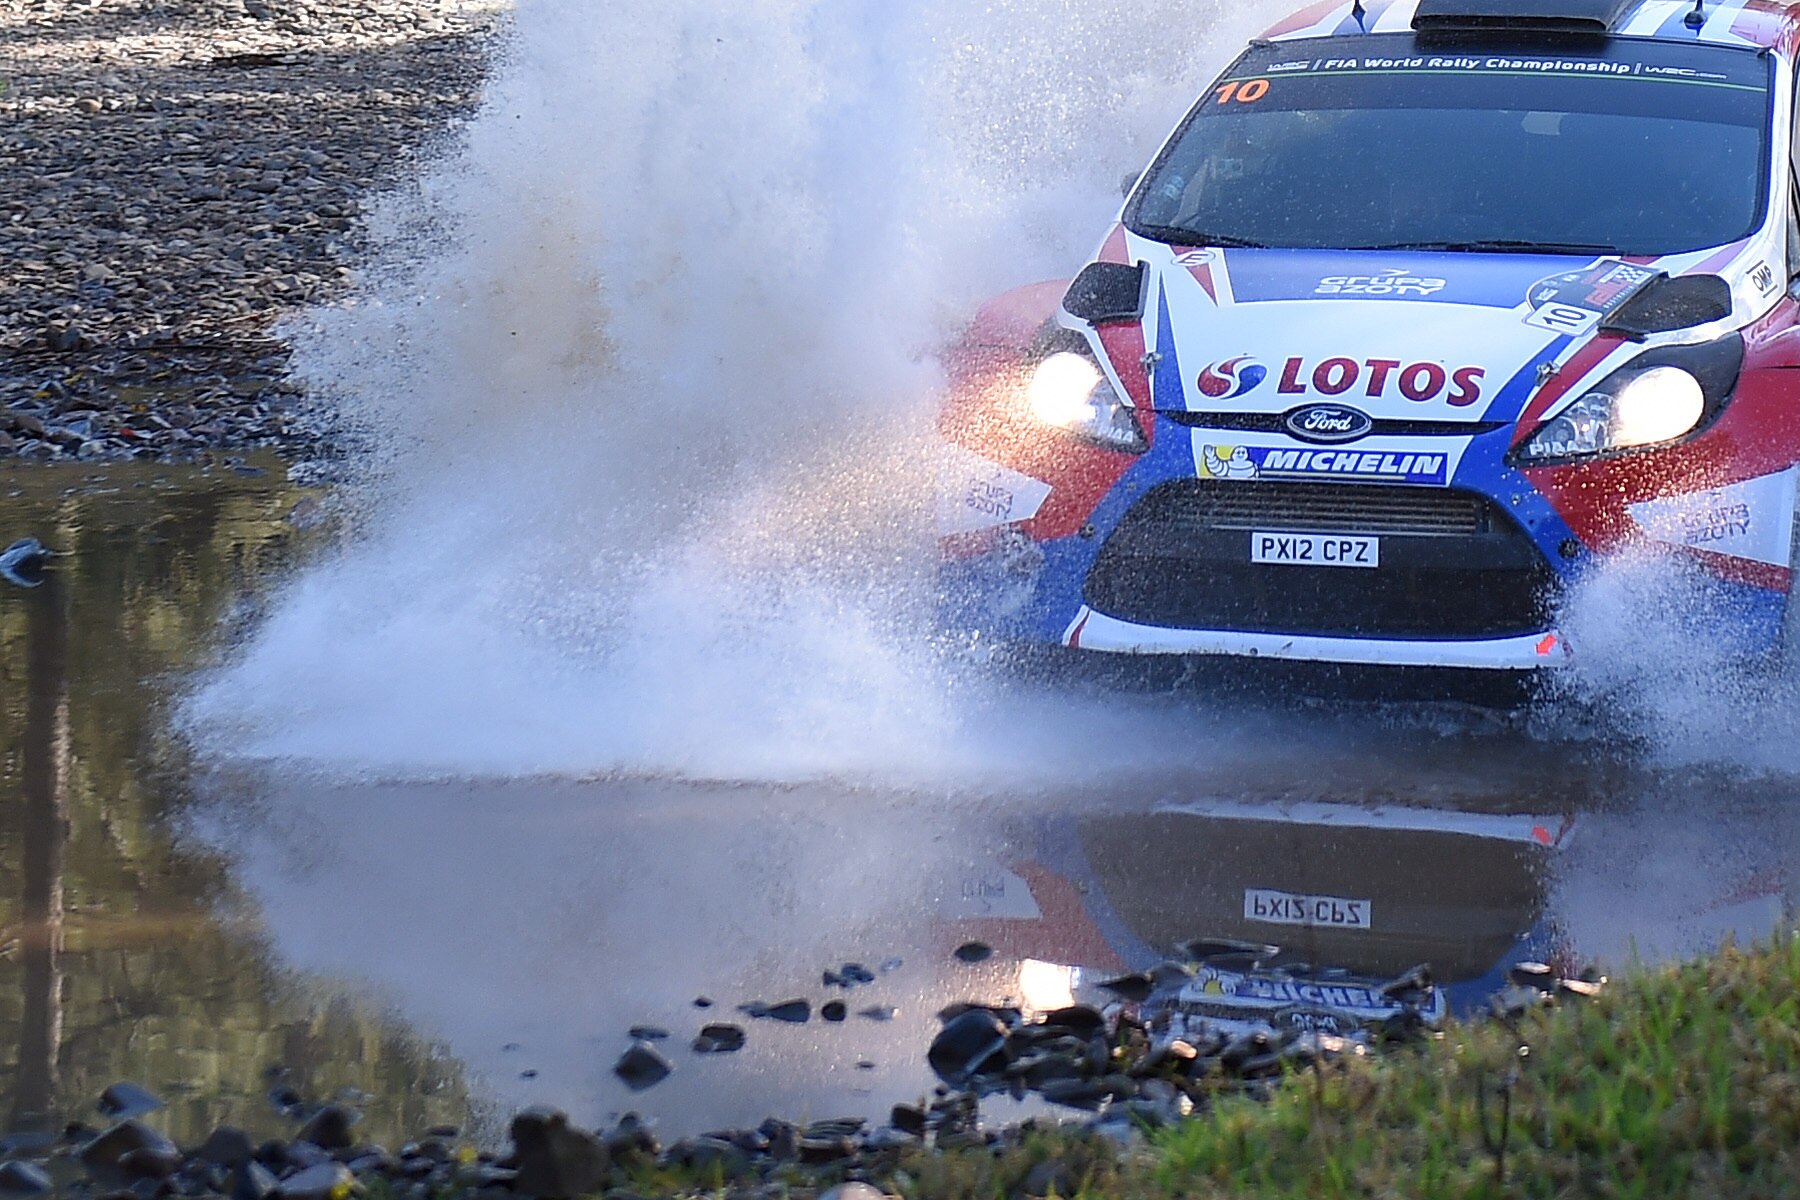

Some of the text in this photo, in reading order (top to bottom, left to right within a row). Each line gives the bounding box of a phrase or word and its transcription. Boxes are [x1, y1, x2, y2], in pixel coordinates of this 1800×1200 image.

[1324, 58, 1358, 69] FIA
[1364, 57, 1424, 69] World
[1427, 57, 1480, 70] Rally
[1485, 57, 1631, 75] Championship
[1214, 79, 1271, 105] 10
[1751, 264, 1774, 292] OMP
[1542, 308, 1588, 327] 10
[1276, 357, 1486, 408] LOTOS
[1303, 409, 1353, 433] Ford
[1260, 450, 1443, 475] MICHELIN
[1261, 537, 1369, 563] PX12 CPZ
